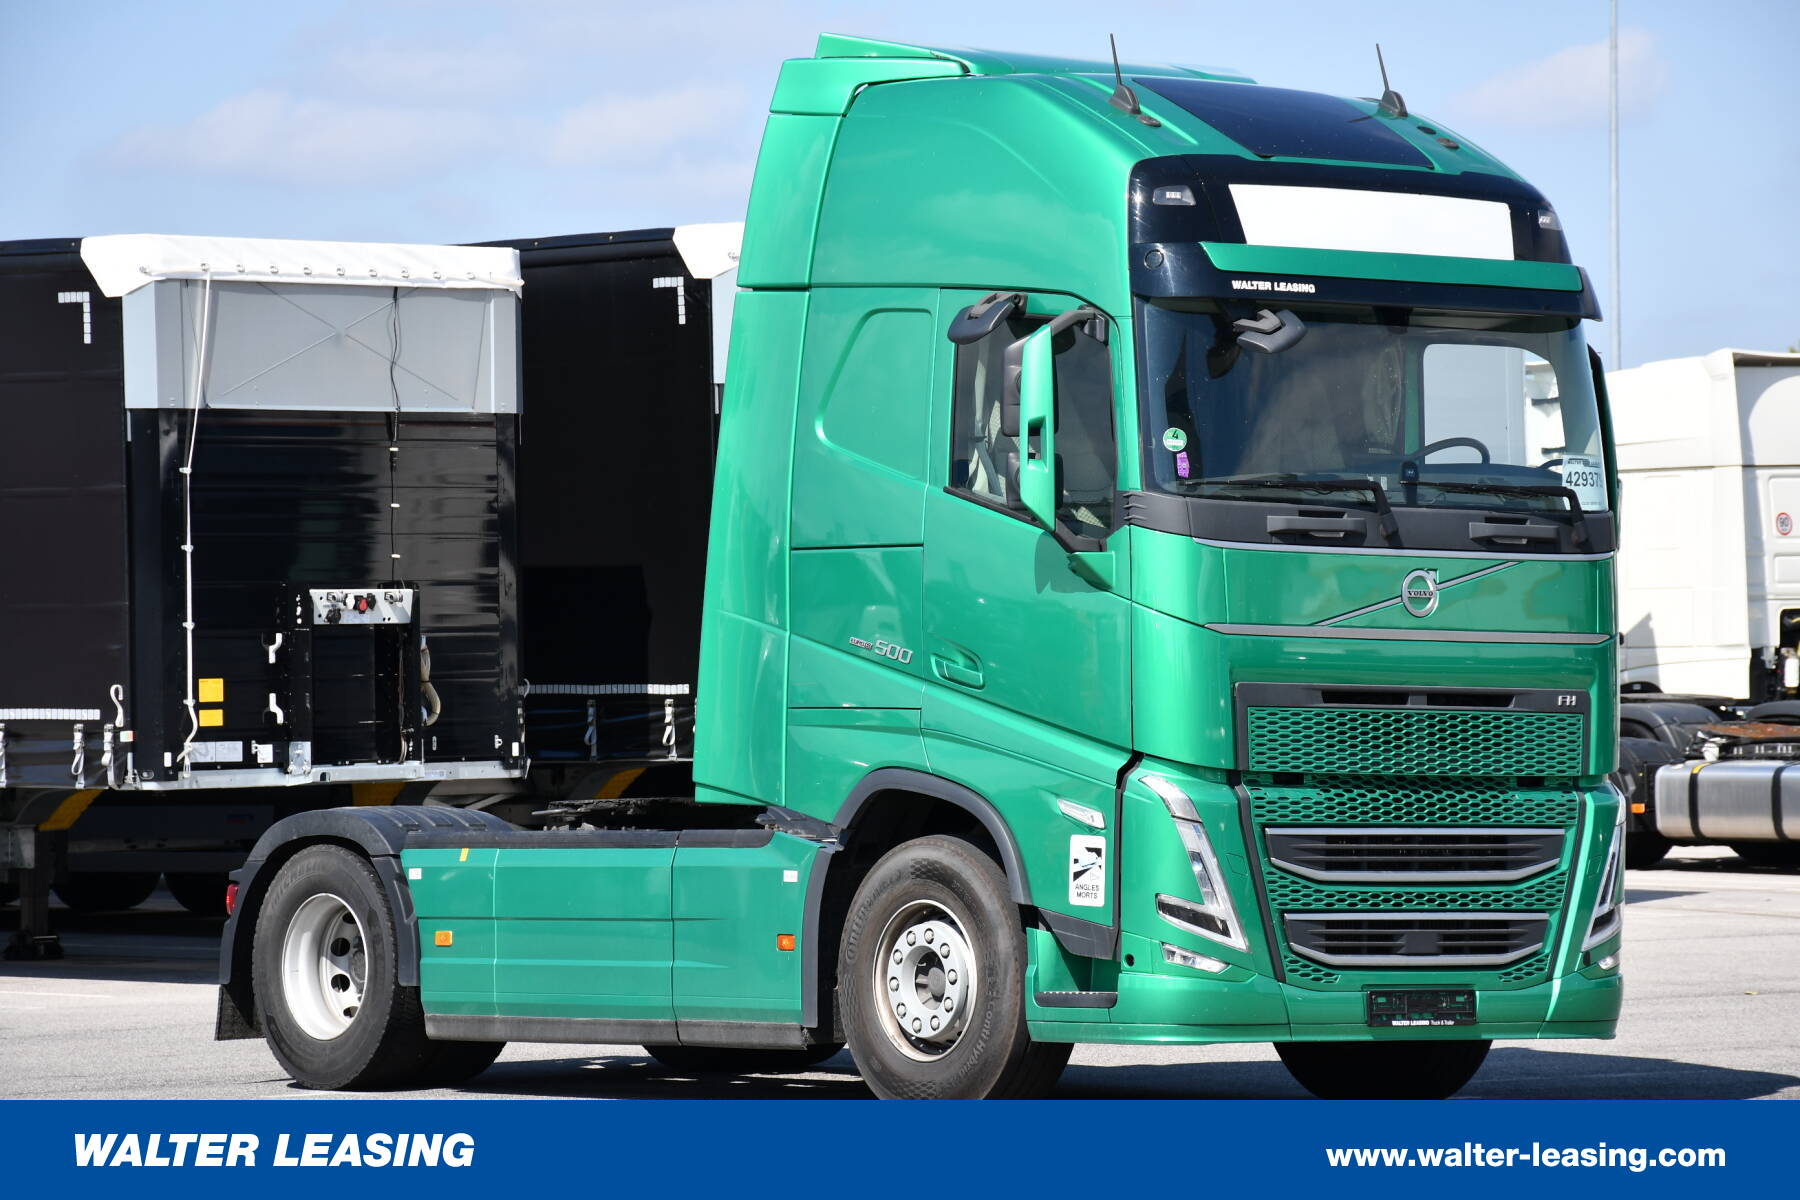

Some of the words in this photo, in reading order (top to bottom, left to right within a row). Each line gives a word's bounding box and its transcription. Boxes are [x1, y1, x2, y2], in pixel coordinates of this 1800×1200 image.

[1232, 280, 1271, 290] WALTER
[1274, 281, 1316, 293] LEASING
[875, 639, 913, 664] 500
[1558, 695, 1577, 706] FH
[1075, 883, 1100, 892] ANGLES
[1076, 891, 1098, 899] MORTS
